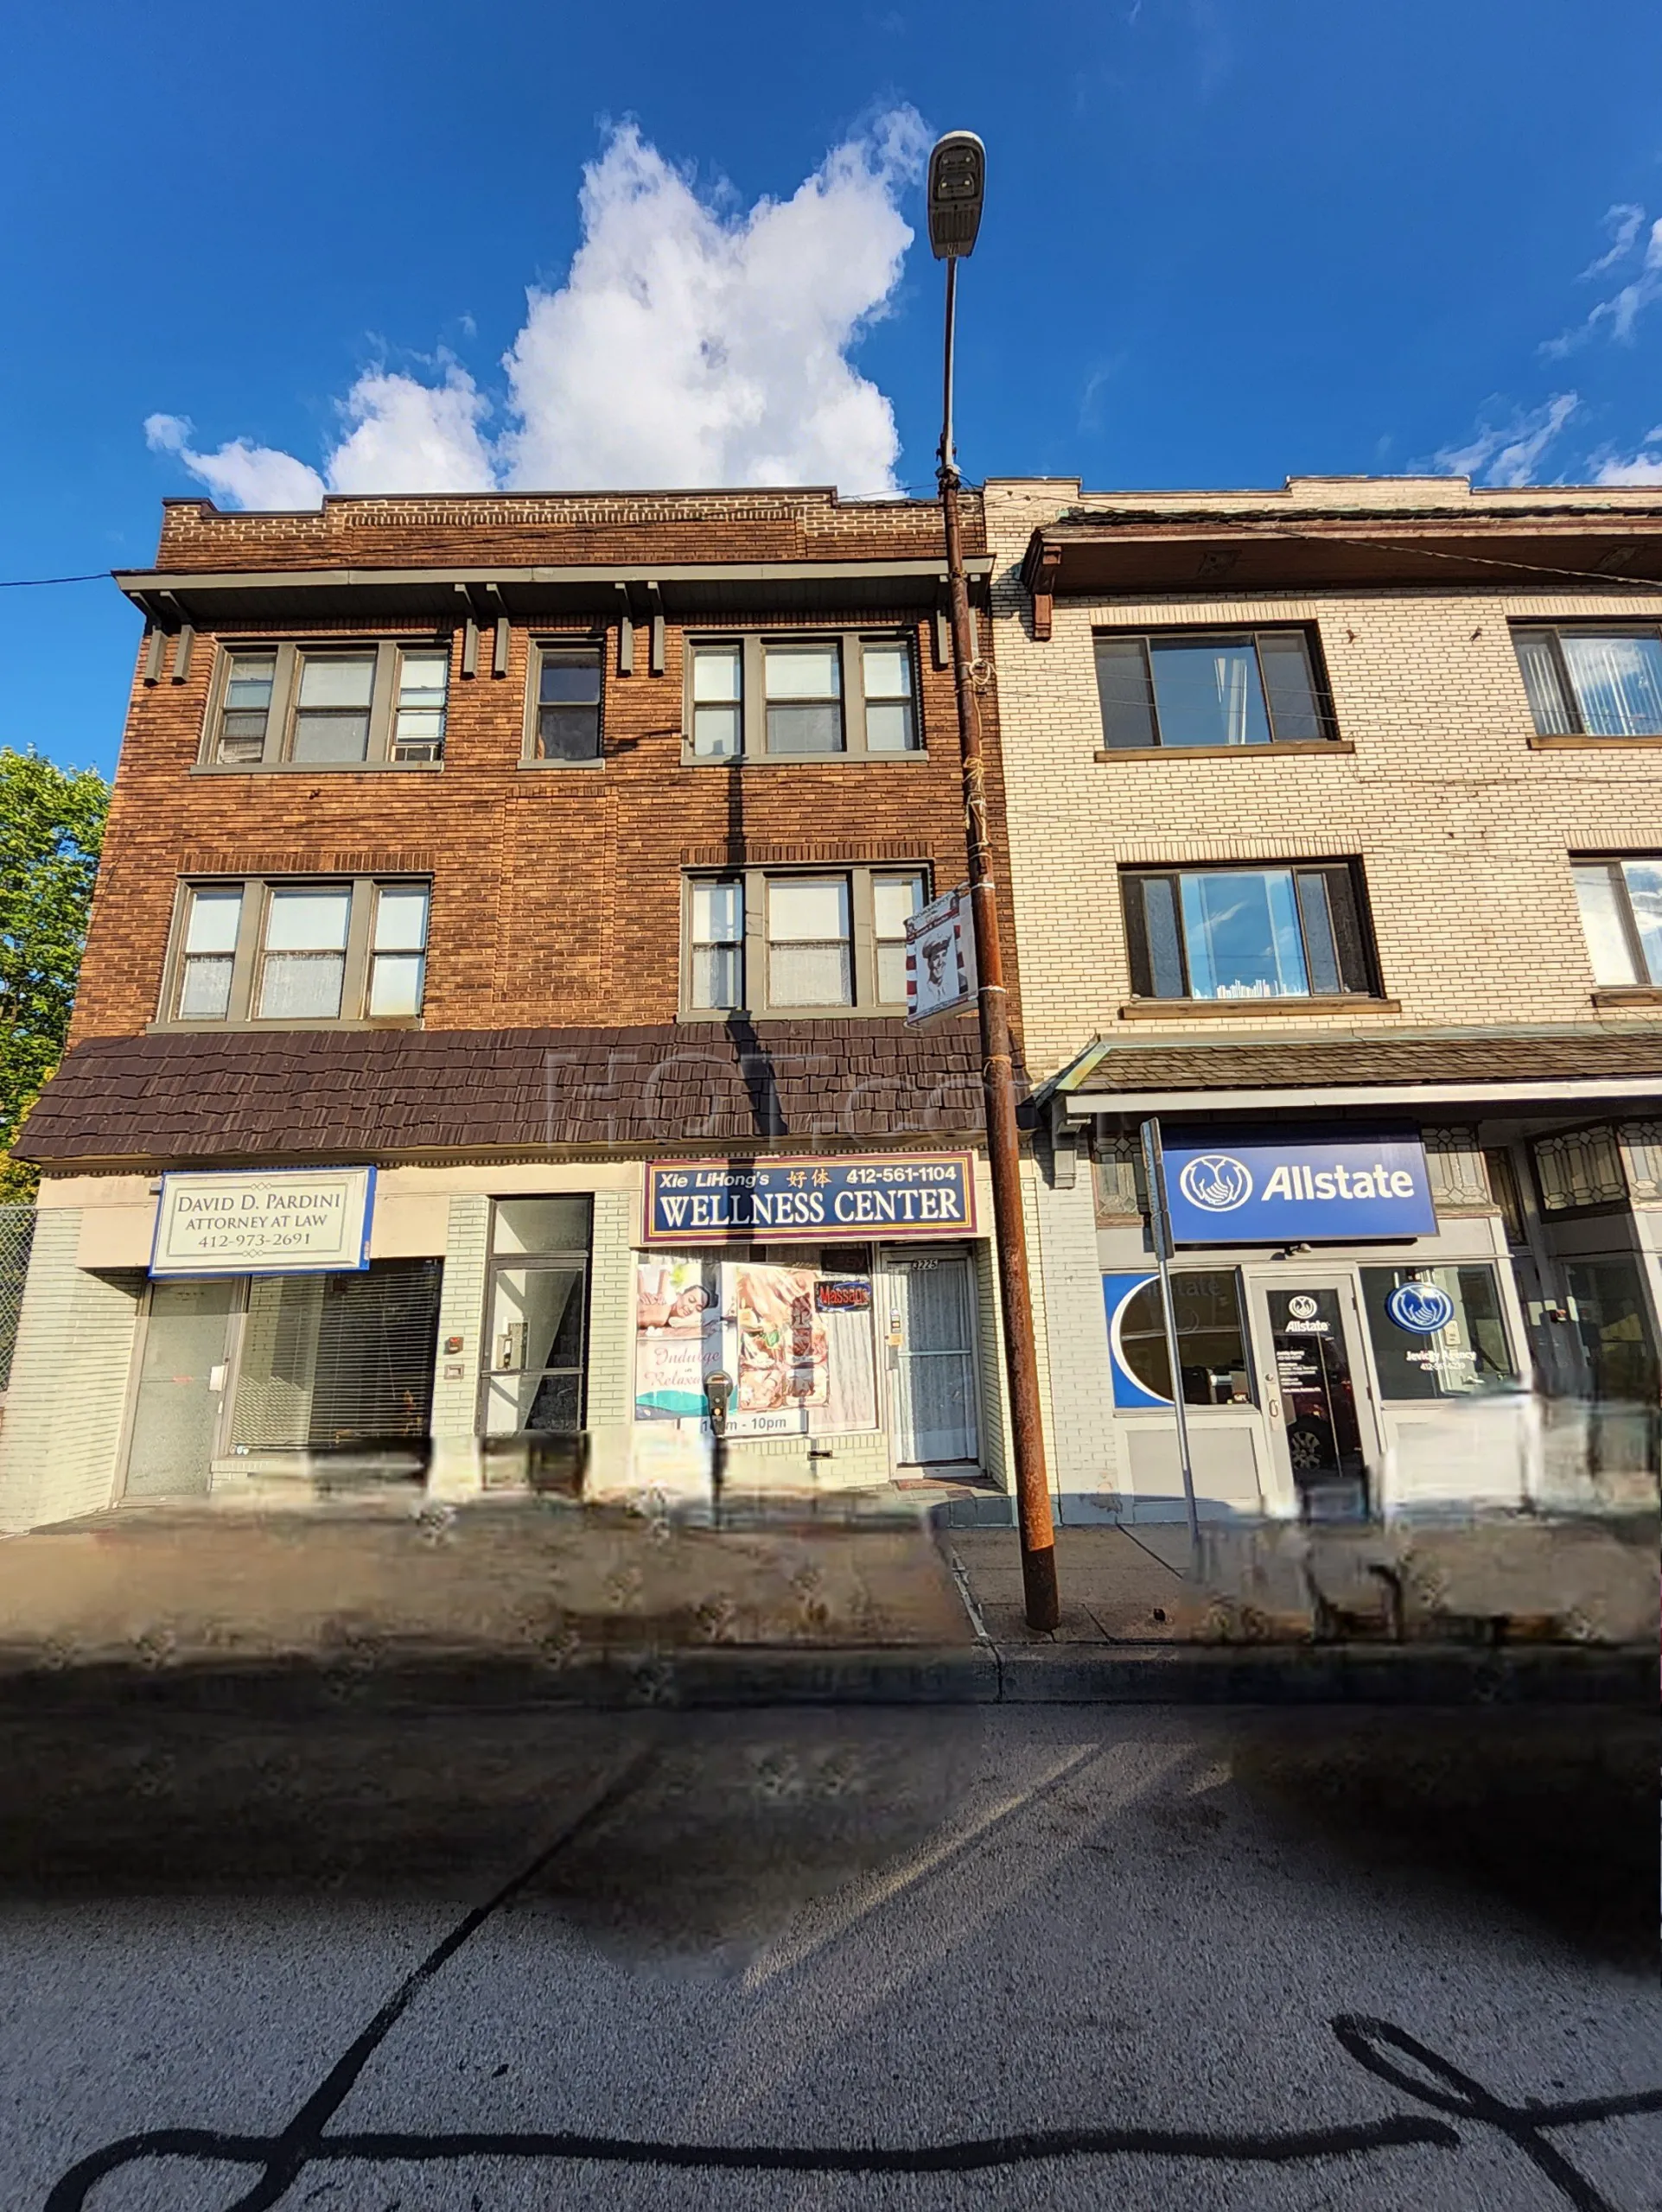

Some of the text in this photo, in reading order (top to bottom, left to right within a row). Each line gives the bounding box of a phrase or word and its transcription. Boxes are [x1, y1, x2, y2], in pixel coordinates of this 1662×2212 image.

[659, 1171, 769, 1189] Xie LiHong's
[846, 1166, 957, 1184] 412-561-1104
[1261, 1164, 1415, 1201] Allstate
[178, 1193, 341, 1212] DAVID D. PARDINI
[659, 1188, 961, 1227] WELLNESS CENTER
[185, 1214, 328, 1230] ATTORNEY AT LAW
[198, 1233, 310, 1248] 412-973-2691
[914, 1259, 938, 1269] 3225
[1285, 1320, 1328, 1332] Allstate
[751, 1417, 786, 1432] 10pm
